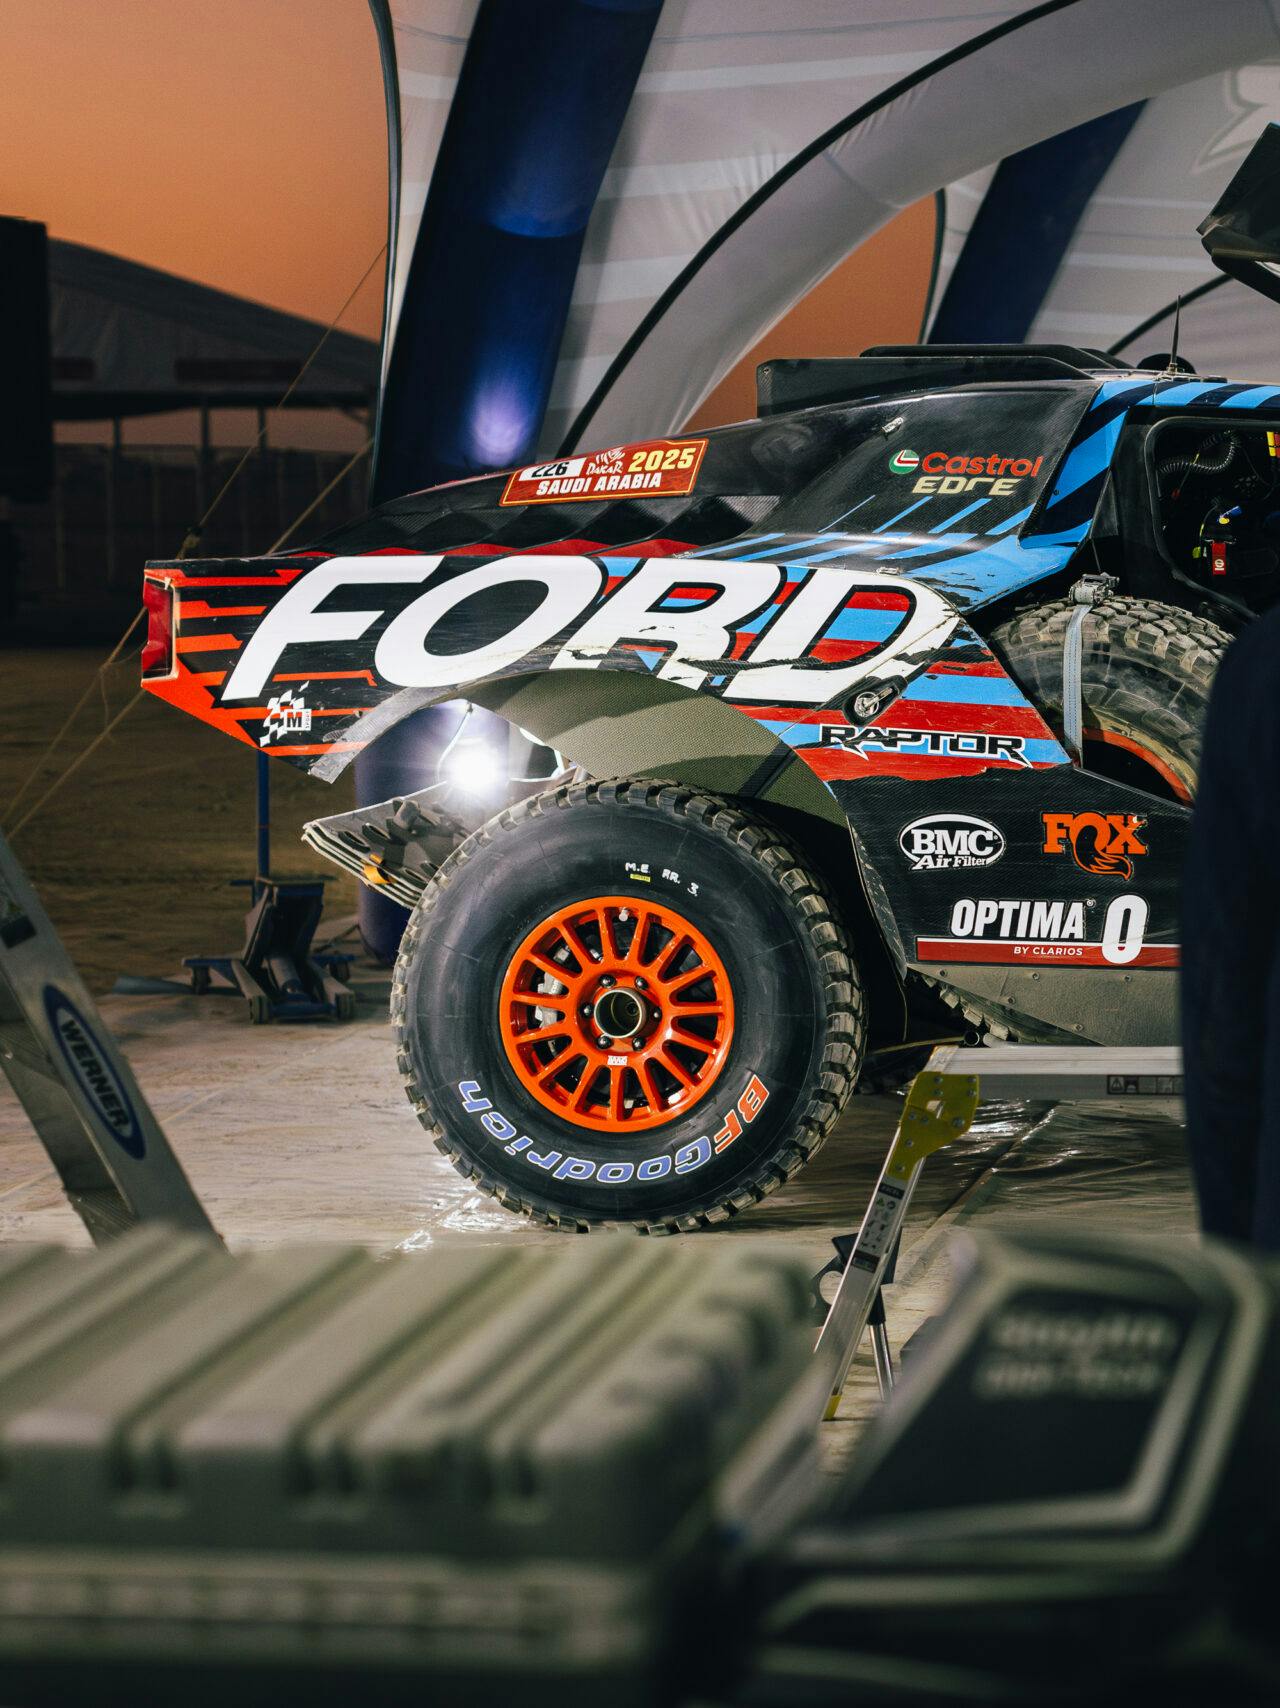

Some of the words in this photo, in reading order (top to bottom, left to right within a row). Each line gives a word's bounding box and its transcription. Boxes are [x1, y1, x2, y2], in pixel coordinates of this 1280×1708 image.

[628, 448, 696, 473] 2025
[922, 452, 1044, 477] Castrol
[536, 476, 590, 495] SAUDI
[594, 472, 662, 491] ARABIA
[221, 556, 958, 703] FORD
[287, 711, 302, 728] M
[819, 724, 1034, 768] RAPTOR
[911, 828, 994, 856] BMC
[1042, 812, 1147, 880] FOX
[912, 855, 952, 870] Air
[953, 855, 986, 868] Filter
[951, 899, 1084, 939] OPTIMA
[1014, 946, 1029, 955] BY
[1032, 946, 1083, 956] CLARIOS
[61, 1020, 129, 1128] WERNER
